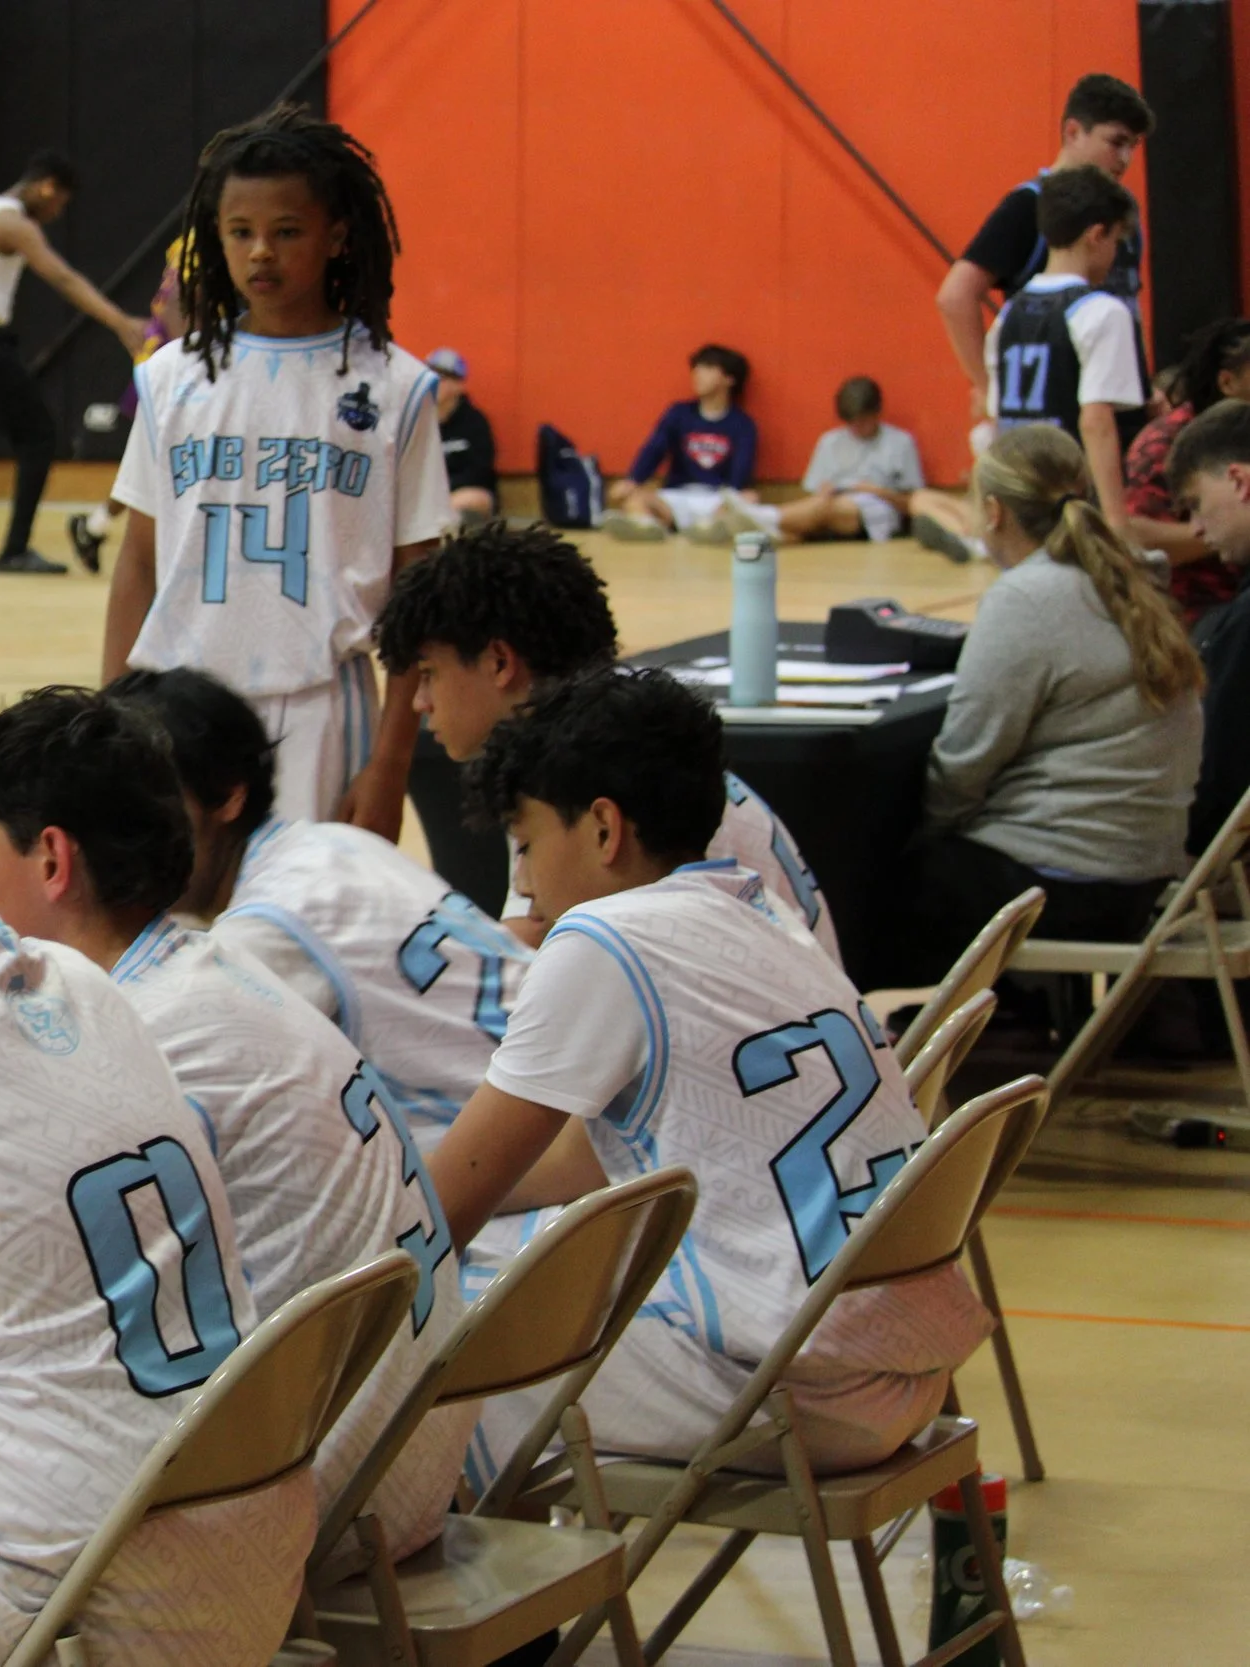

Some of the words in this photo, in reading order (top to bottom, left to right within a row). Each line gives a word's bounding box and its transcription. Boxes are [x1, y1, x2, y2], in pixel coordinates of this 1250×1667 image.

[1002, 344, 1050, 411] 17
[169, 433, 243, 498] SUB
[256, 437, 371, 497] ZERO
[197, 487, 309, 607] 14
[66, 1135, 241, 1398] 0
